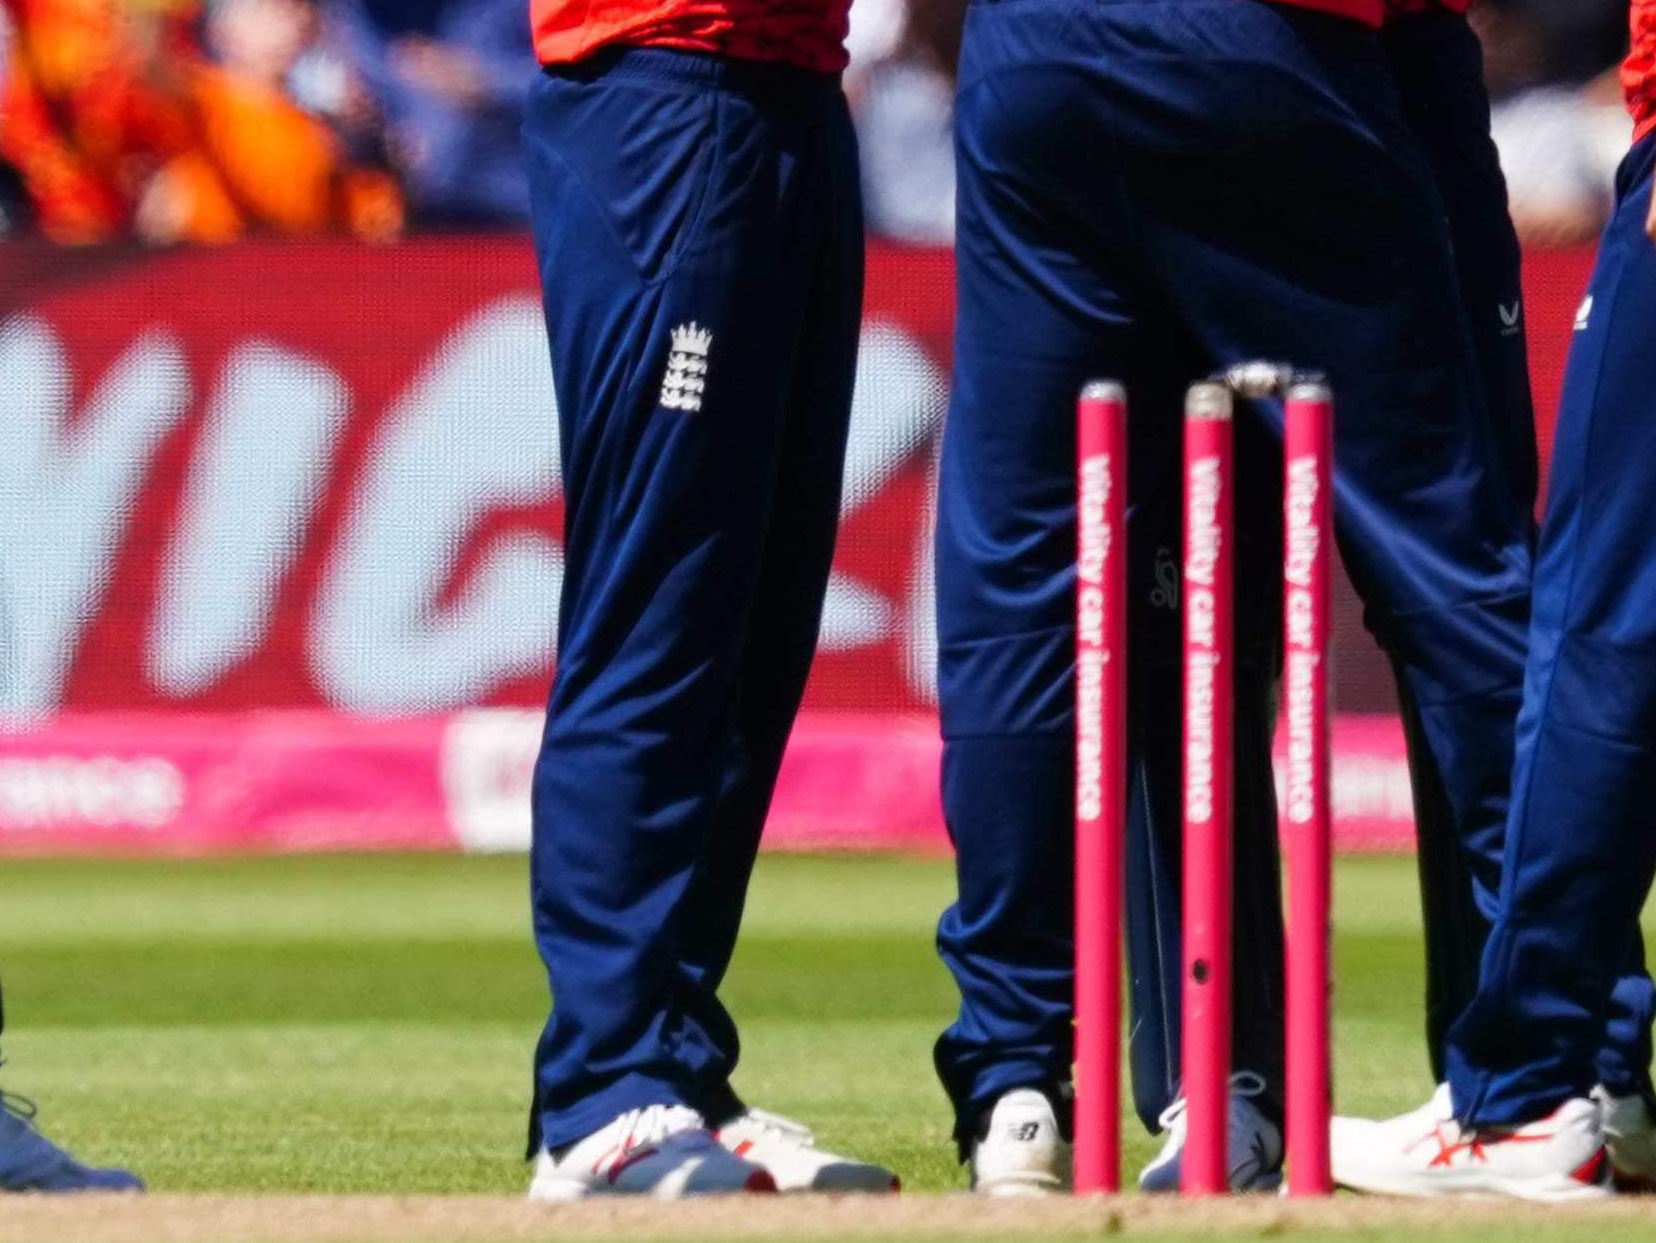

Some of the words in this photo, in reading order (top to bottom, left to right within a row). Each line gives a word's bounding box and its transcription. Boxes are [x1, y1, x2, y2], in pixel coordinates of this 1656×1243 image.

[1077, 454, 1111, 583] Vitality
[1185, 455, 1222, 585] Vitality
[1284, 455, 1320, 585] Vitality
[1078, 587, 1104, 646] car
[1187, 589, 1214, 646] car
[1287, 589, 1313, 647] car
[1077, 648, 1111, 821] insurance
[1186, 650, 1221, 823] insurance
[1287, 650, 1321, 823] insurance
